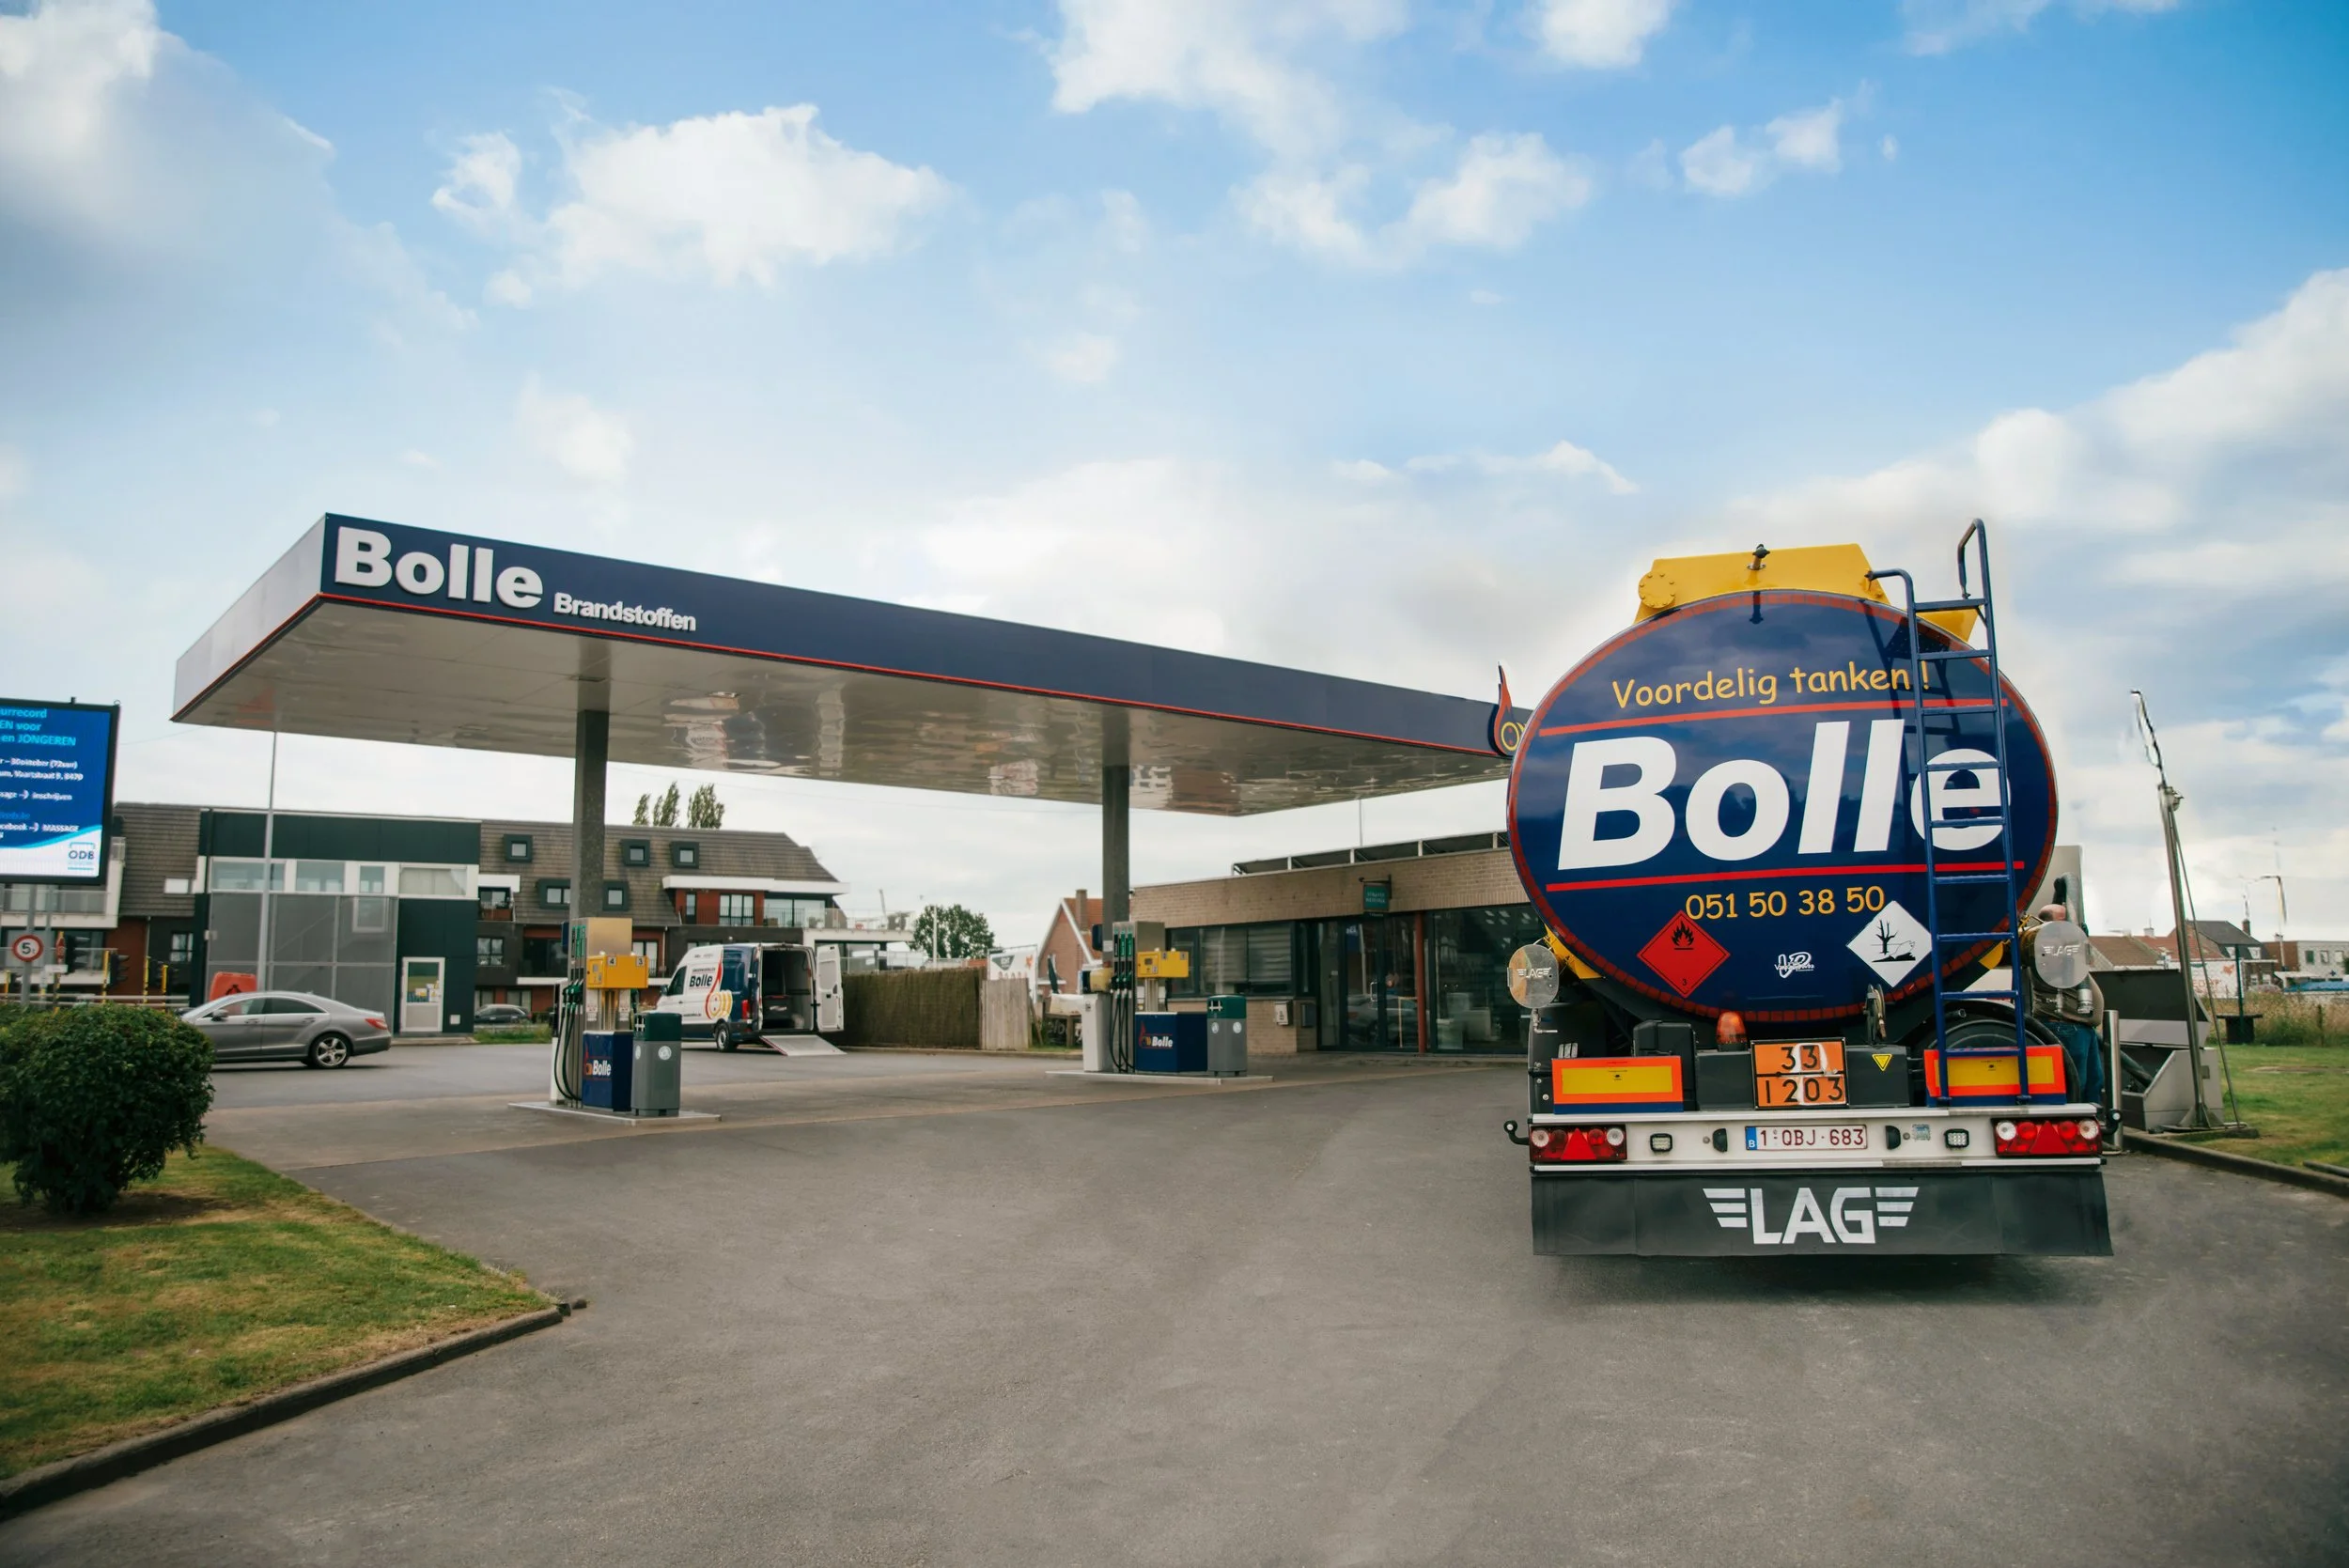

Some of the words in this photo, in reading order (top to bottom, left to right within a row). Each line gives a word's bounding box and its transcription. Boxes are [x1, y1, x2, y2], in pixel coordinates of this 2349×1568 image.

[334, 526, 544, 609] Bolle
[554, 592, 696, 631] Brandstoffen
[1612, 667, 1778, 708] Voordelig
[1789, 660, 1911, 693] tanken
[16, 722, 41, 731] voor
[18, 734, 76, 746] JONGEREN
[1558, 719, 2012, 871] Bolle
[1686, 893, 1738, 920] 051
[1749, 891, 1787, 918] 50
[1798, 888, 1836, 915] 38
[1846, 885, 1885, 913] 50
[689, 974, 713, 987] Bolle
[1681, 978, 1688, 986] 3
[592, 1059, 612, 1077] Bolle
[1781, 1045, 1819, 1070] 33
[1765, 1077, 1843, 1104] 1203
[1750, 1187, 1876, 1245] LAG
